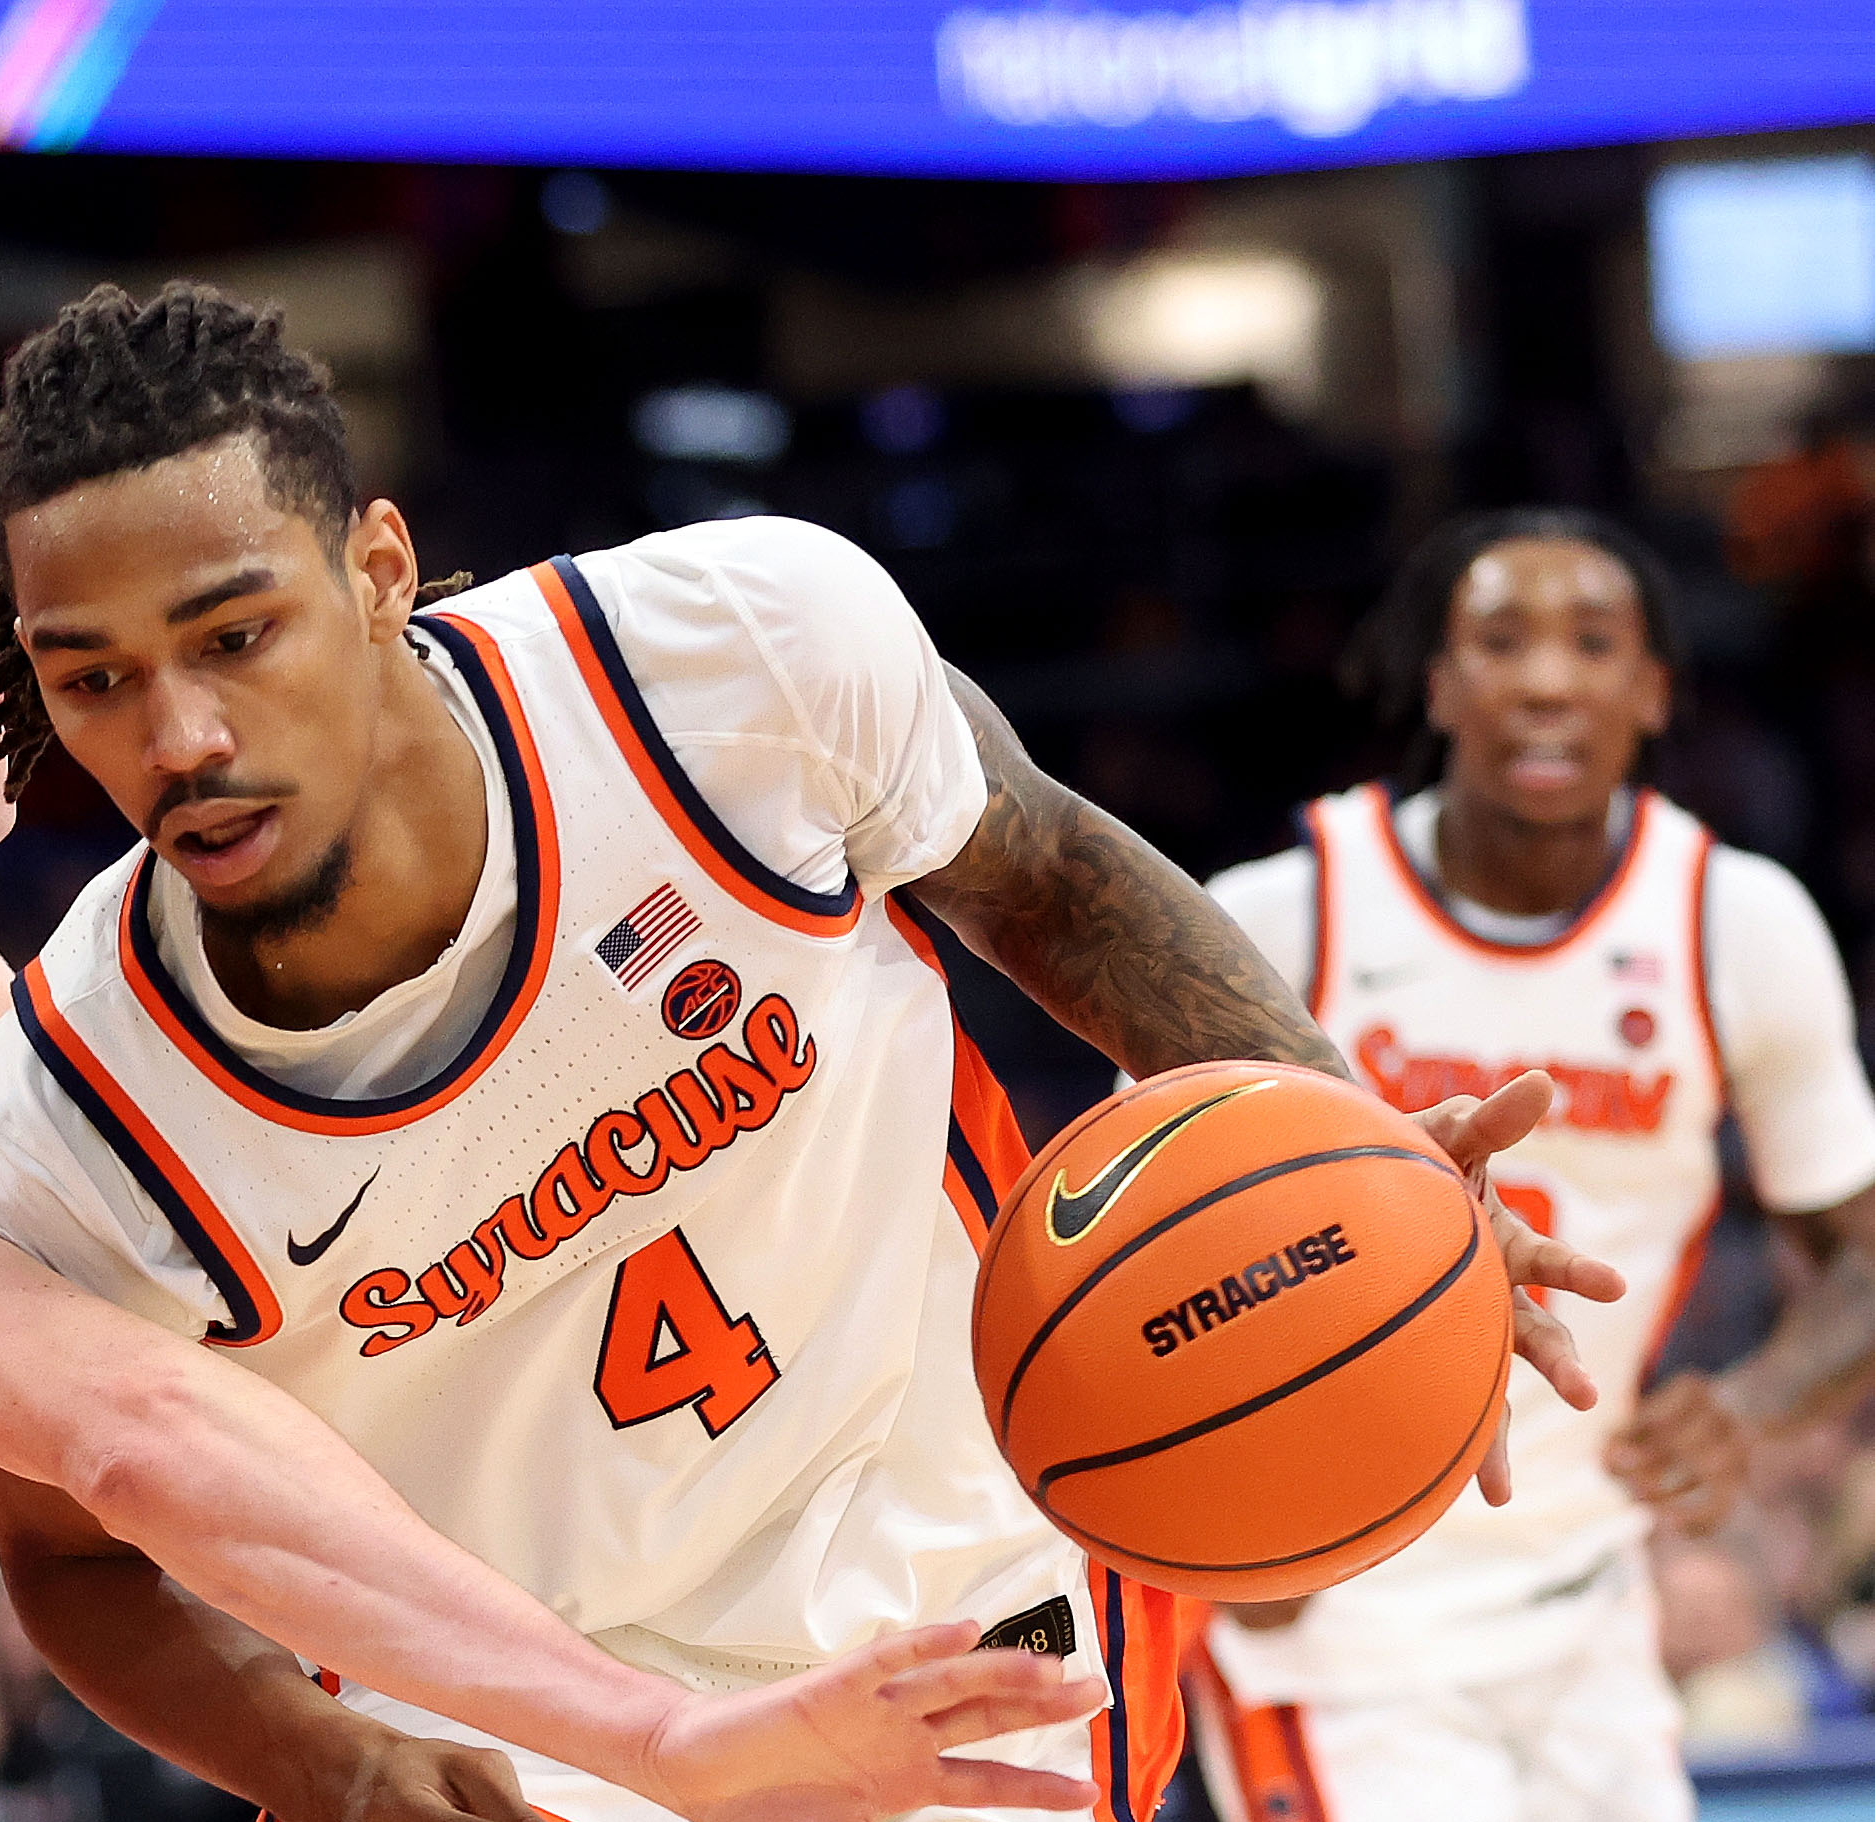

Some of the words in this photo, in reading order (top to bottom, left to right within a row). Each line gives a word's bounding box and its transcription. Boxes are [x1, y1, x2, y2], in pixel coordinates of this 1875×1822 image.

[339, 993, 816, 1357] Syracuse
[593, 1225, 782, 1441] 4
[1141, 1223, 1357, 1359] SYRACUSE
